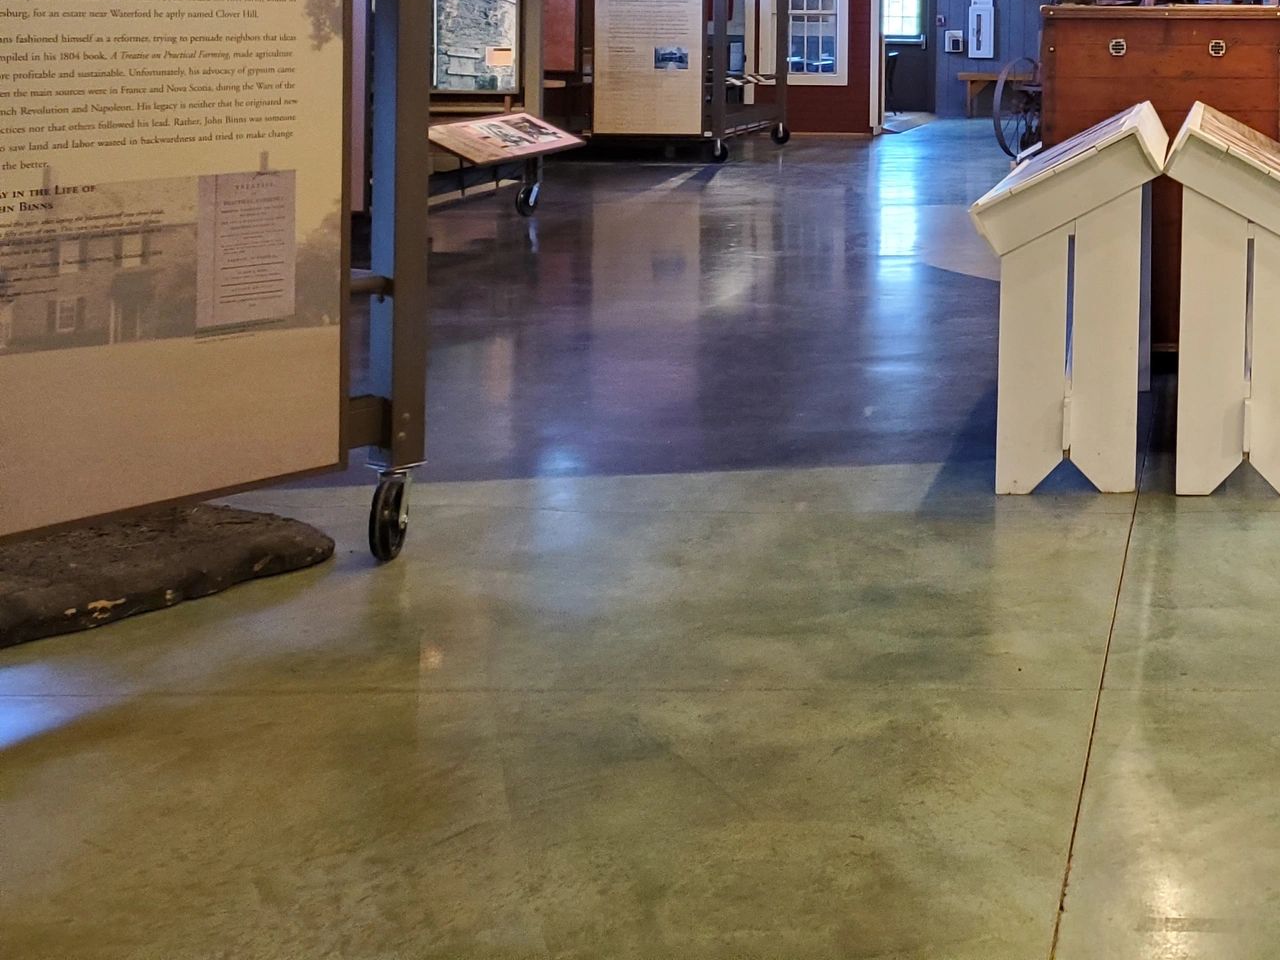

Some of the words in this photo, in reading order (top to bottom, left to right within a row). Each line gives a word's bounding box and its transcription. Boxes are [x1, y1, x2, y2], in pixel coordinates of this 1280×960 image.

[62, 9, 86, 17] estate
[88, 10, 106, 18] near
[110, 6, 151, 18] Waterford
[165, 7, 184, 21] aptly
[187, 7, 213, 18] named
[215, 7, 239, 18] Clover
[15, 32, 58, 43] fashioned
[60, 32, 92, 43] himself
[113, 31, 148, 44] reformer,
[152, 34, 177, 45] trying
[189, 31, 222, 45] persuade
[225, 31, 260, 45] neighbors
[262, 31, 276, 42] that
[279, 31, 295, 42] ideas
[59, 49, 80, 60] 1804
[82, 49, 106, 62] book,
[121, 48, 148, 60] Treatise
[163, 48, 196, 59] Practical
[198, 48, 230, 62] Farming,
[233, 47, 252, 59] made
[255, 47, 291, 61] agriculture
[12, 67, 55, 82] profitable
[77, 66, 123, 78] sustainable.
[128, 65, 184, 80] Unfortunately,
[202, 64, 234, 78] advocacy
[246, 67, 275, 77] gypsum
[29, 87, 52, 97] main
[55, 88, 85, 96] sources
[88, 87, 106, 95] were
[120, 82, 146, 94] France
[166, 81, 186, 93] Nova
[189, 81, 212, 94] Scotia,
[215, 80, 240, 94] during
[256, 79, 272, 91] Wars
[19, 102, 68, 115] Revolution
[90, 100, 131, 115] Napoleon.
[153, 98, 177, 113] legacy
[188, 97, 215, 109] neither
[217, 96, 232, 108] that
[245, 95, 282, 110] originated
[47, 120, 65, 132] that
[97, 117, 135, 130] followed
[151, 116, 170, 128] lead.
[172, 114, 201, 128] Rather,
[204, 114, 222, 128] John
[224, 112, 246, 124] Binns
[28, 139, 48, 151] land
[71, 136, 95, 149] labor
[96, 135, 126, 147] wasted
[140, 131, 195, 145] backwardness
[215, 129, 233, 141] tried
[246, 128, 264, 140] make
[268, 126, 292, 141] change
[19, 157, 49, 169] better.
[30, 188, 51, 197] THE
[55, 185, 78, 195] LIFE
[82, 185, 97, 193] OF
[19, 201, 54, 212] BINNS
